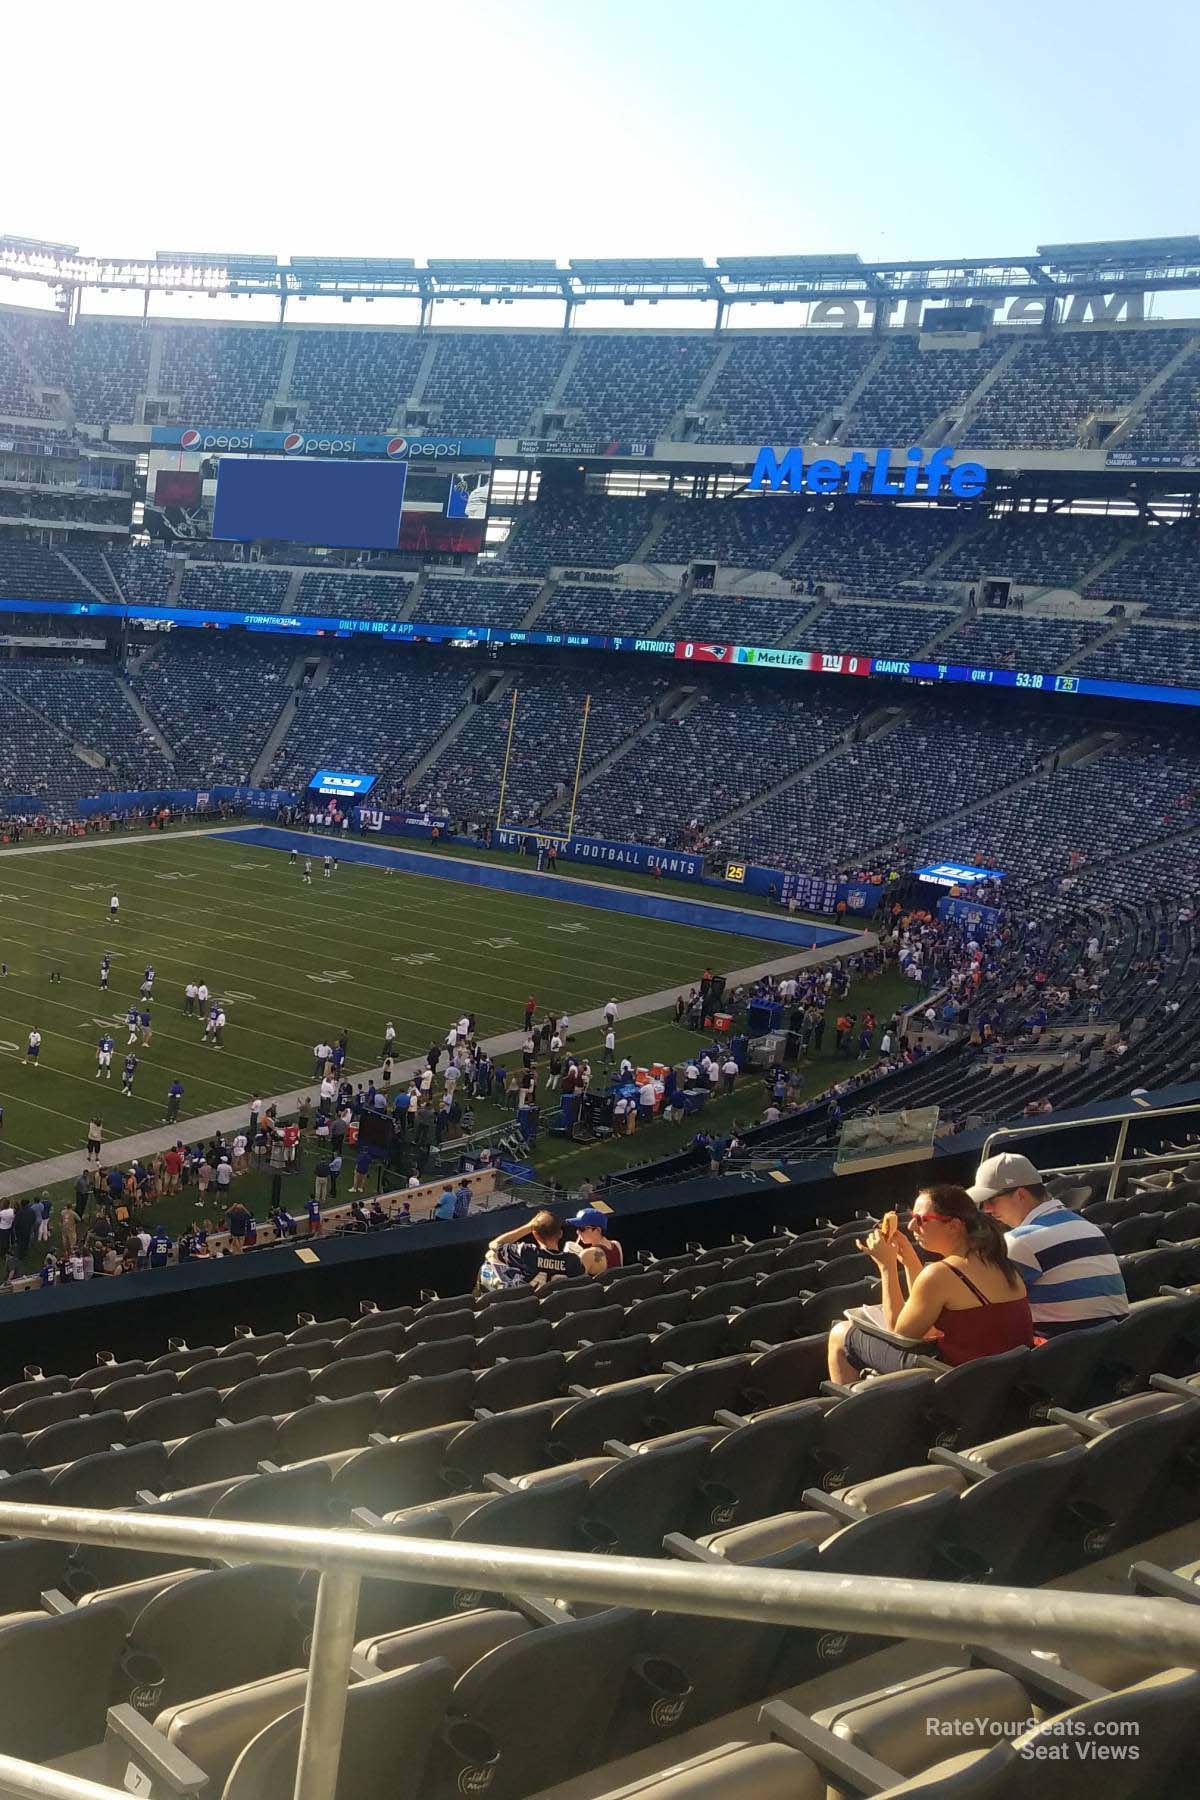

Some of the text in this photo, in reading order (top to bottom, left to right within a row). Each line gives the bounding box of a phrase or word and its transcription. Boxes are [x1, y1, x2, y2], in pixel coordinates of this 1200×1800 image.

[203, 433, 254, 450] pepsi
[304, 437, 356, 454] pepsi
[409, 441, 461, 456] pepsi
[747, 446, 988, 498] MetLife
[339, 620, 414, 634] ONLY ON NBC 4 APP
[635, 640, 693, 657] PATRIOTS 0
[757, 652, 804, 666] MetLife
[849, 657, 858, 672] 0
[875, 661, 910, 673] GIANTS
[971, 670, 985, 681] QTR
[1016, 673, 1043, 689] 53:18
[1062, 679, 1073, 690] 25
[575, 843, 640, 865] FOOTBALL
[647, 855, 695, 875] GIANTS
[728, 866, 744, 879] 25
[156, 1243, 167, 1254] 26
[537, 1256, 566, 1271] ROGUE
[135, 1774, 143, 1789] 7
